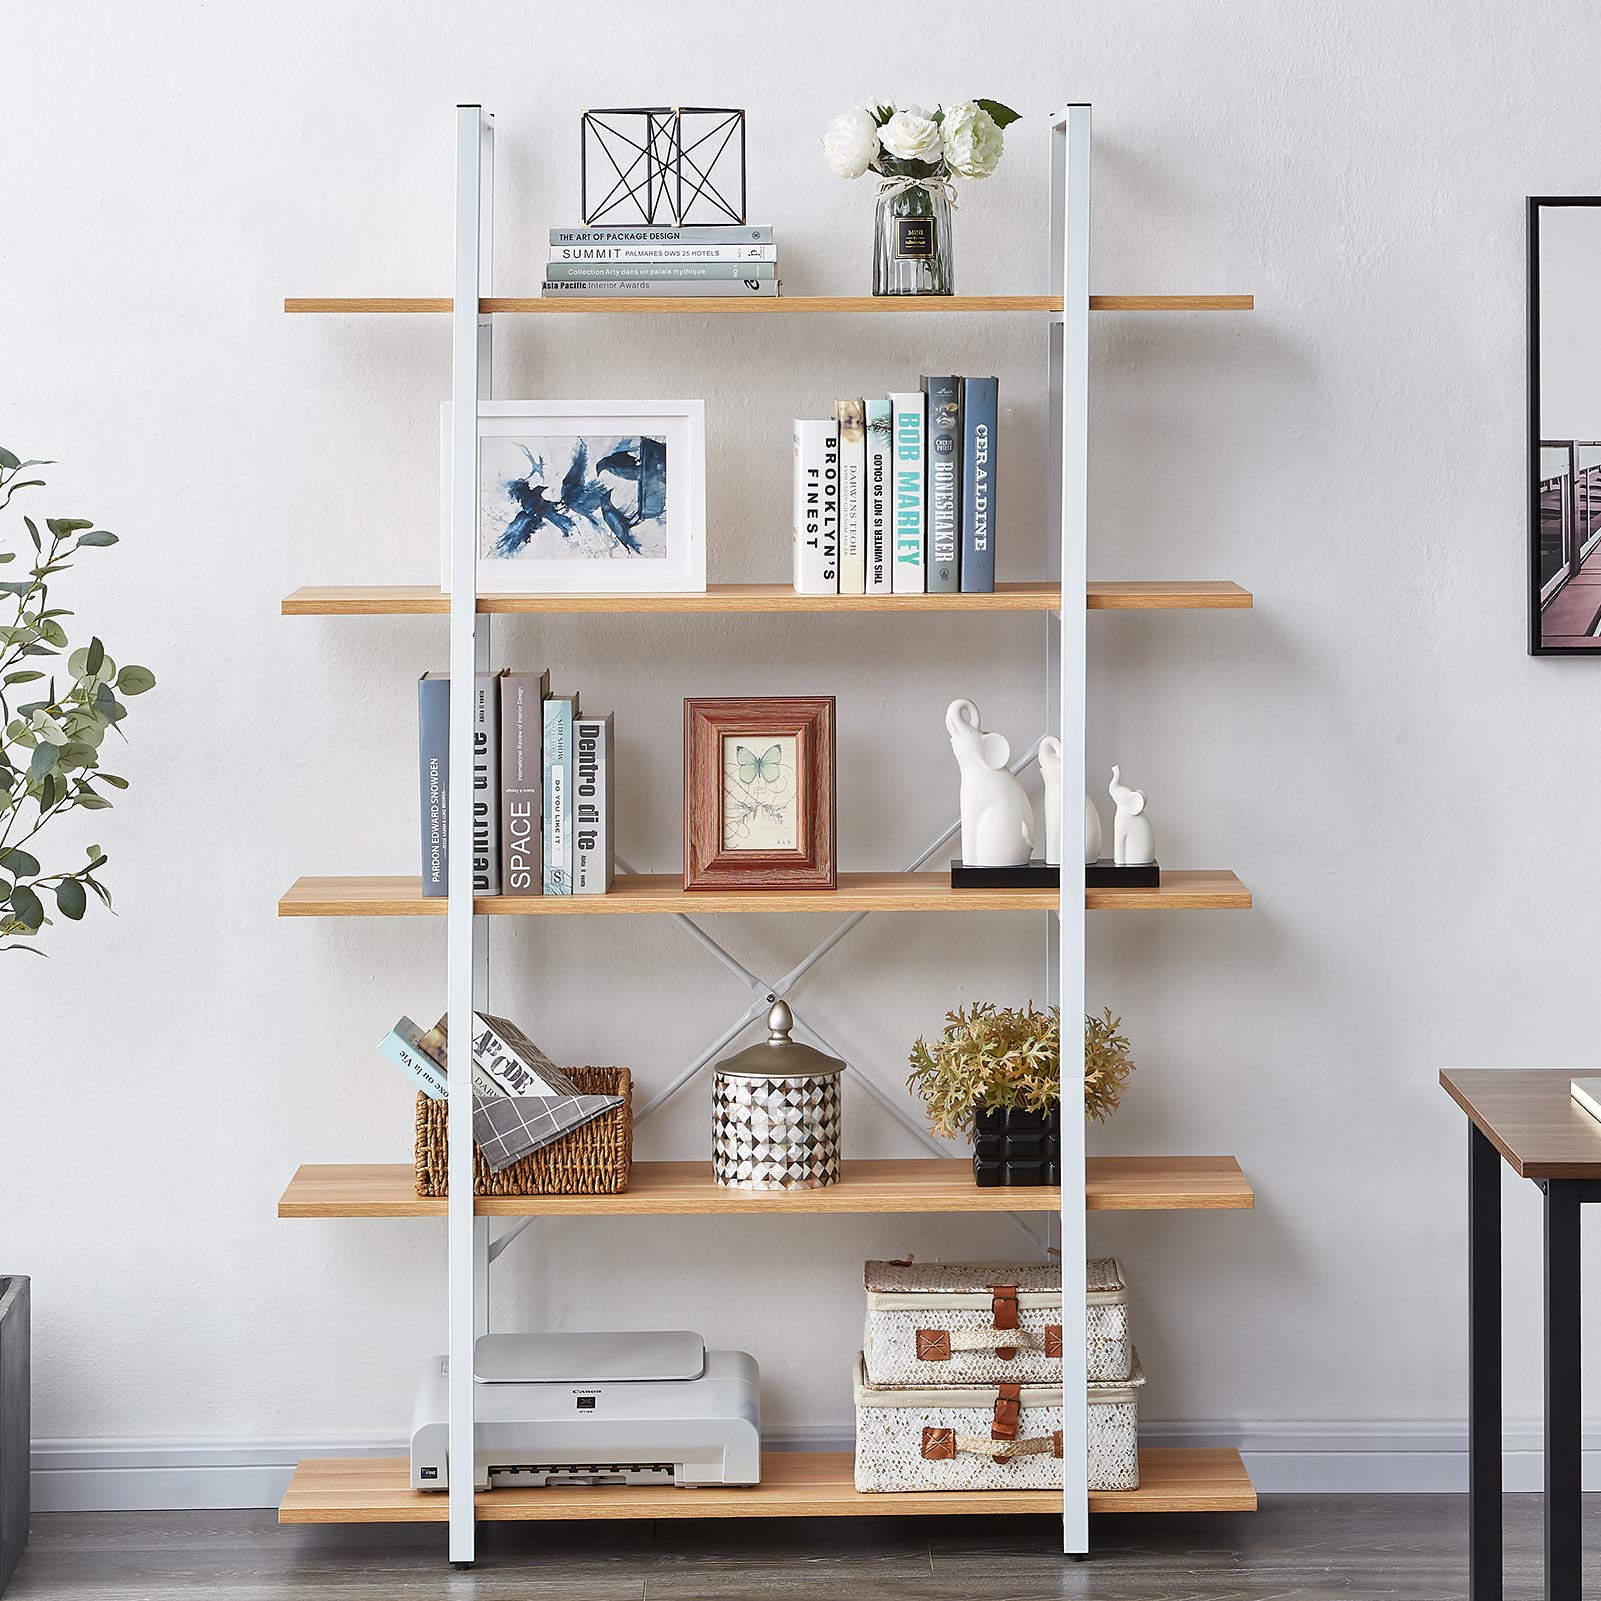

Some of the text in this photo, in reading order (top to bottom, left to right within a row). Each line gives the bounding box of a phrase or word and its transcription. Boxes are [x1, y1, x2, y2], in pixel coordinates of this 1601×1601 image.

[559, 232, 680, 241] THE ART OF PACKAGE DESIGN
[562, 248, 622, 259] SUMMIT
[567, 268, 604, 276] Collection
[605, 268, 620, 277] Arty
[620, 268, 638, 276] dans
[650, 268, 672, 276] palais
[672, 268, 706, 276] mythique
[541, 282, 559, 290] Asia
[560, 282, 587, 290] Pacific
[619, 281, 650, 289] Awards
[874, 484, 883, 497] SO
[897, 413, 920, 566] BOB MARLEY
[806, 468, 819, 548] FINEST
[823, 437, 837, 580] BROOKLYN'S
[849, 465, 857, 556] DARWINS TEORI
[874, 499, 883, 516] NOT
[934, 462, 954, 562] BONESHAKER
[874, 518, 883, 527] IS
[874, 530, 883, 559] WINTER
[874, 560, 883, 584] THIS
[555, 779, 561, 792] DO
[578, 724, 600, 850] Dentro di te
[430, 758, 441, 883] PARDON EDWARD SNOWDEN
[510, 801, 531, 889] SPACE
[555, 836, 561, 844] IT
[399, 1050, 413, 1067] Vie
[414, 1064, 423, 1075] la
[422, 1072, 434, 1084] ou
